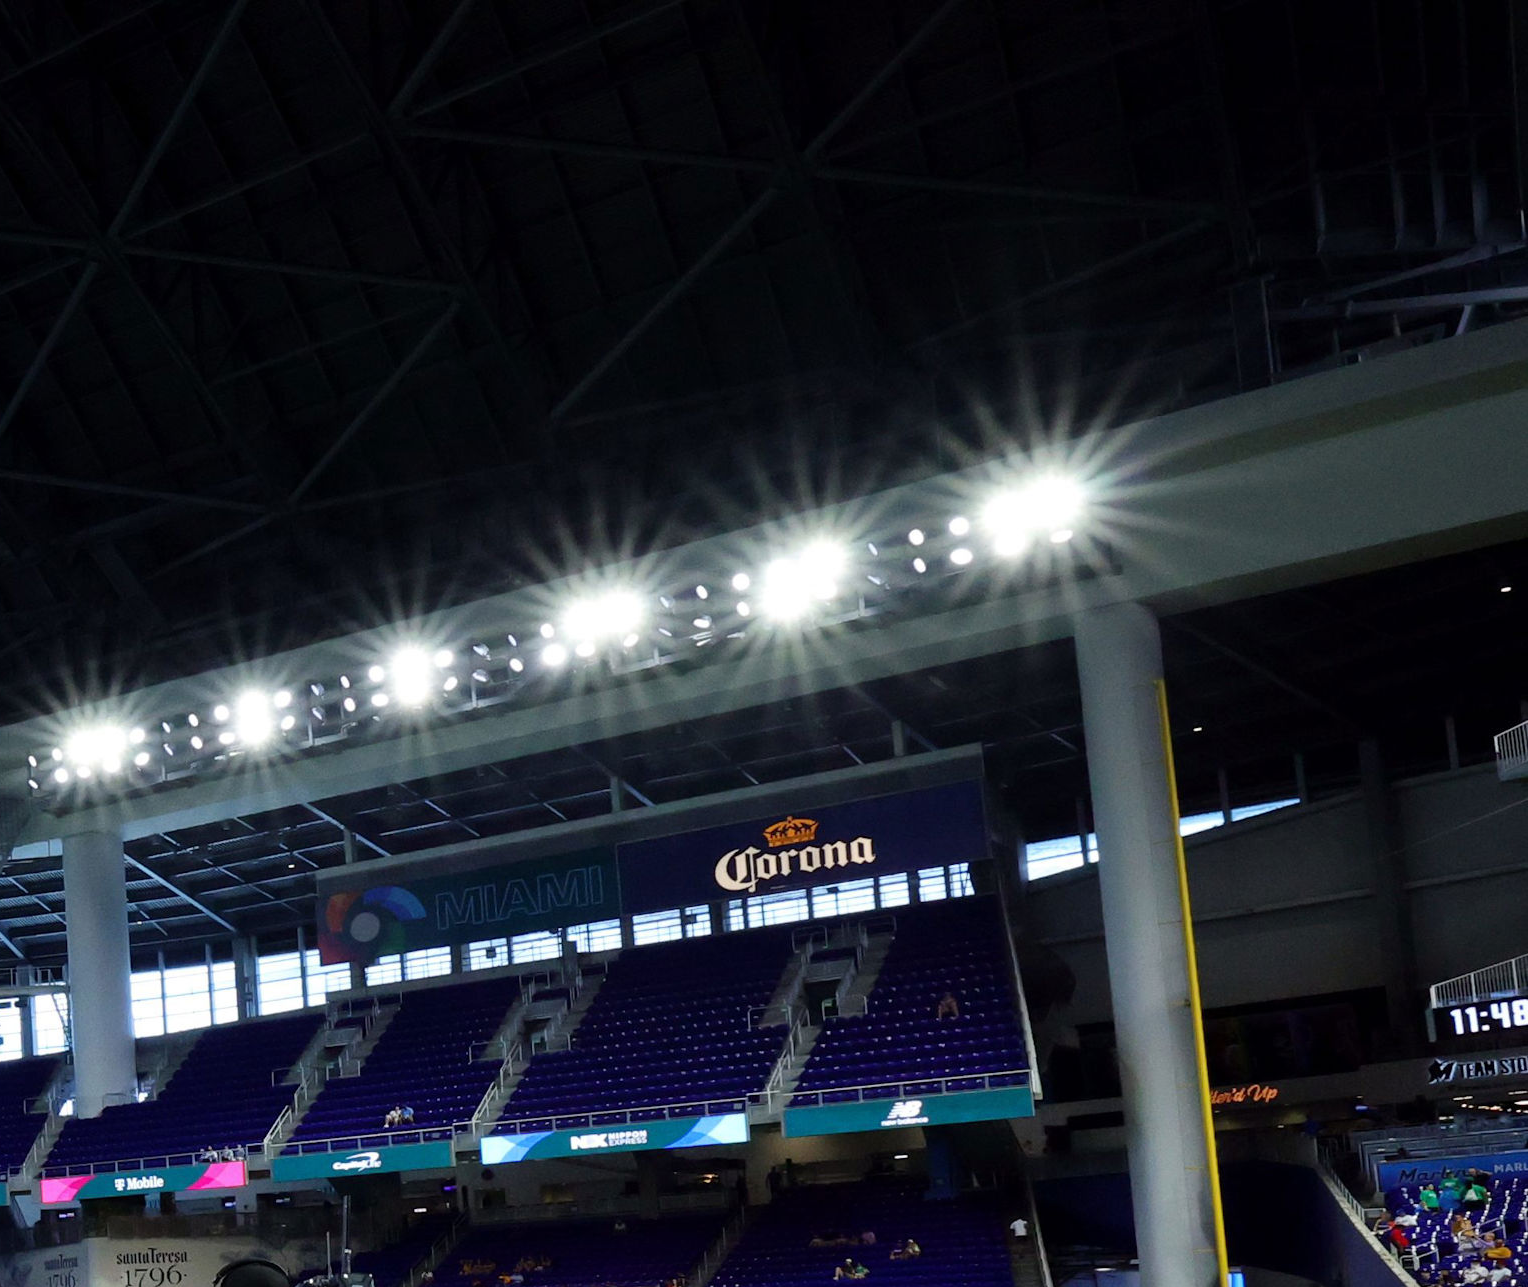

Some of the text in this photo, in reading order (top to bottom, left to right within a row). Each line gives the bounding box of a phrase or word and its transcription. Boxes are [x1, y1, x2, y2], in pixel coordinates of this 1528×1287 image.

[714, 834, 876, 893] Corona
[436, 866, 604, 931] MIAMI
[1459, 1058, 1498, 1079] TEAM
[1247, 1084, 1279, 1103] Up
[608, 1129, 648, 1140] NIPPON
[608, 1137, 648, 1147] EXPRESS
[126, 1175, 164, 1191] Mobile
